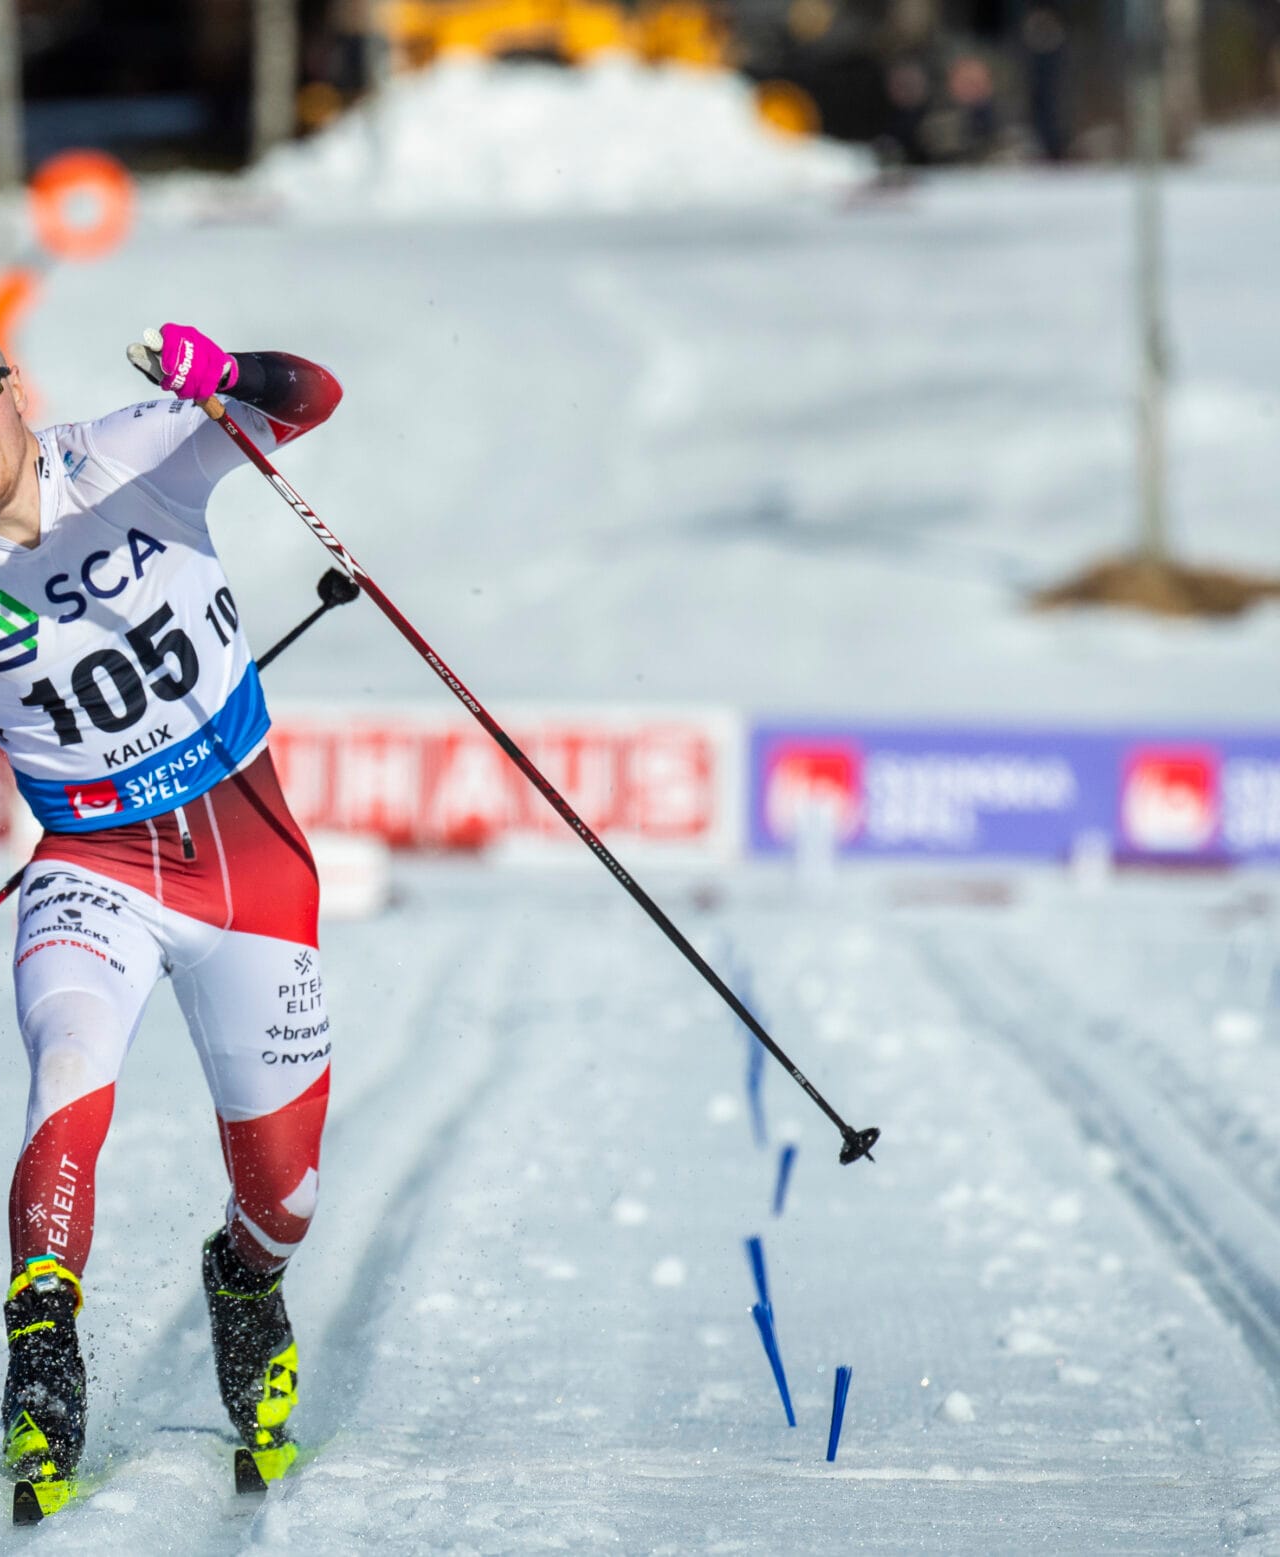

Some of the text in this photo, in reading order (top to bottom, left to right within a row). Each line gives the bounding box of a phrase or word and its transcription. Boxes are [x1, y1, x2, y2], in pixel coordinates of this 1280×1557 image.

[45, 527, 168, 624] SCA
[205, 586, 238, 648] 10
[21, 600, 200, 747] 105
[103, 724, 173, 769] KALIX
[125, 732, 223, 797] SVENSKA
[130, 777, 189, 809] SPEL
[28, 922, 110, 945] LINDBÄCKS
[109, 957, 126, 975] Bil
